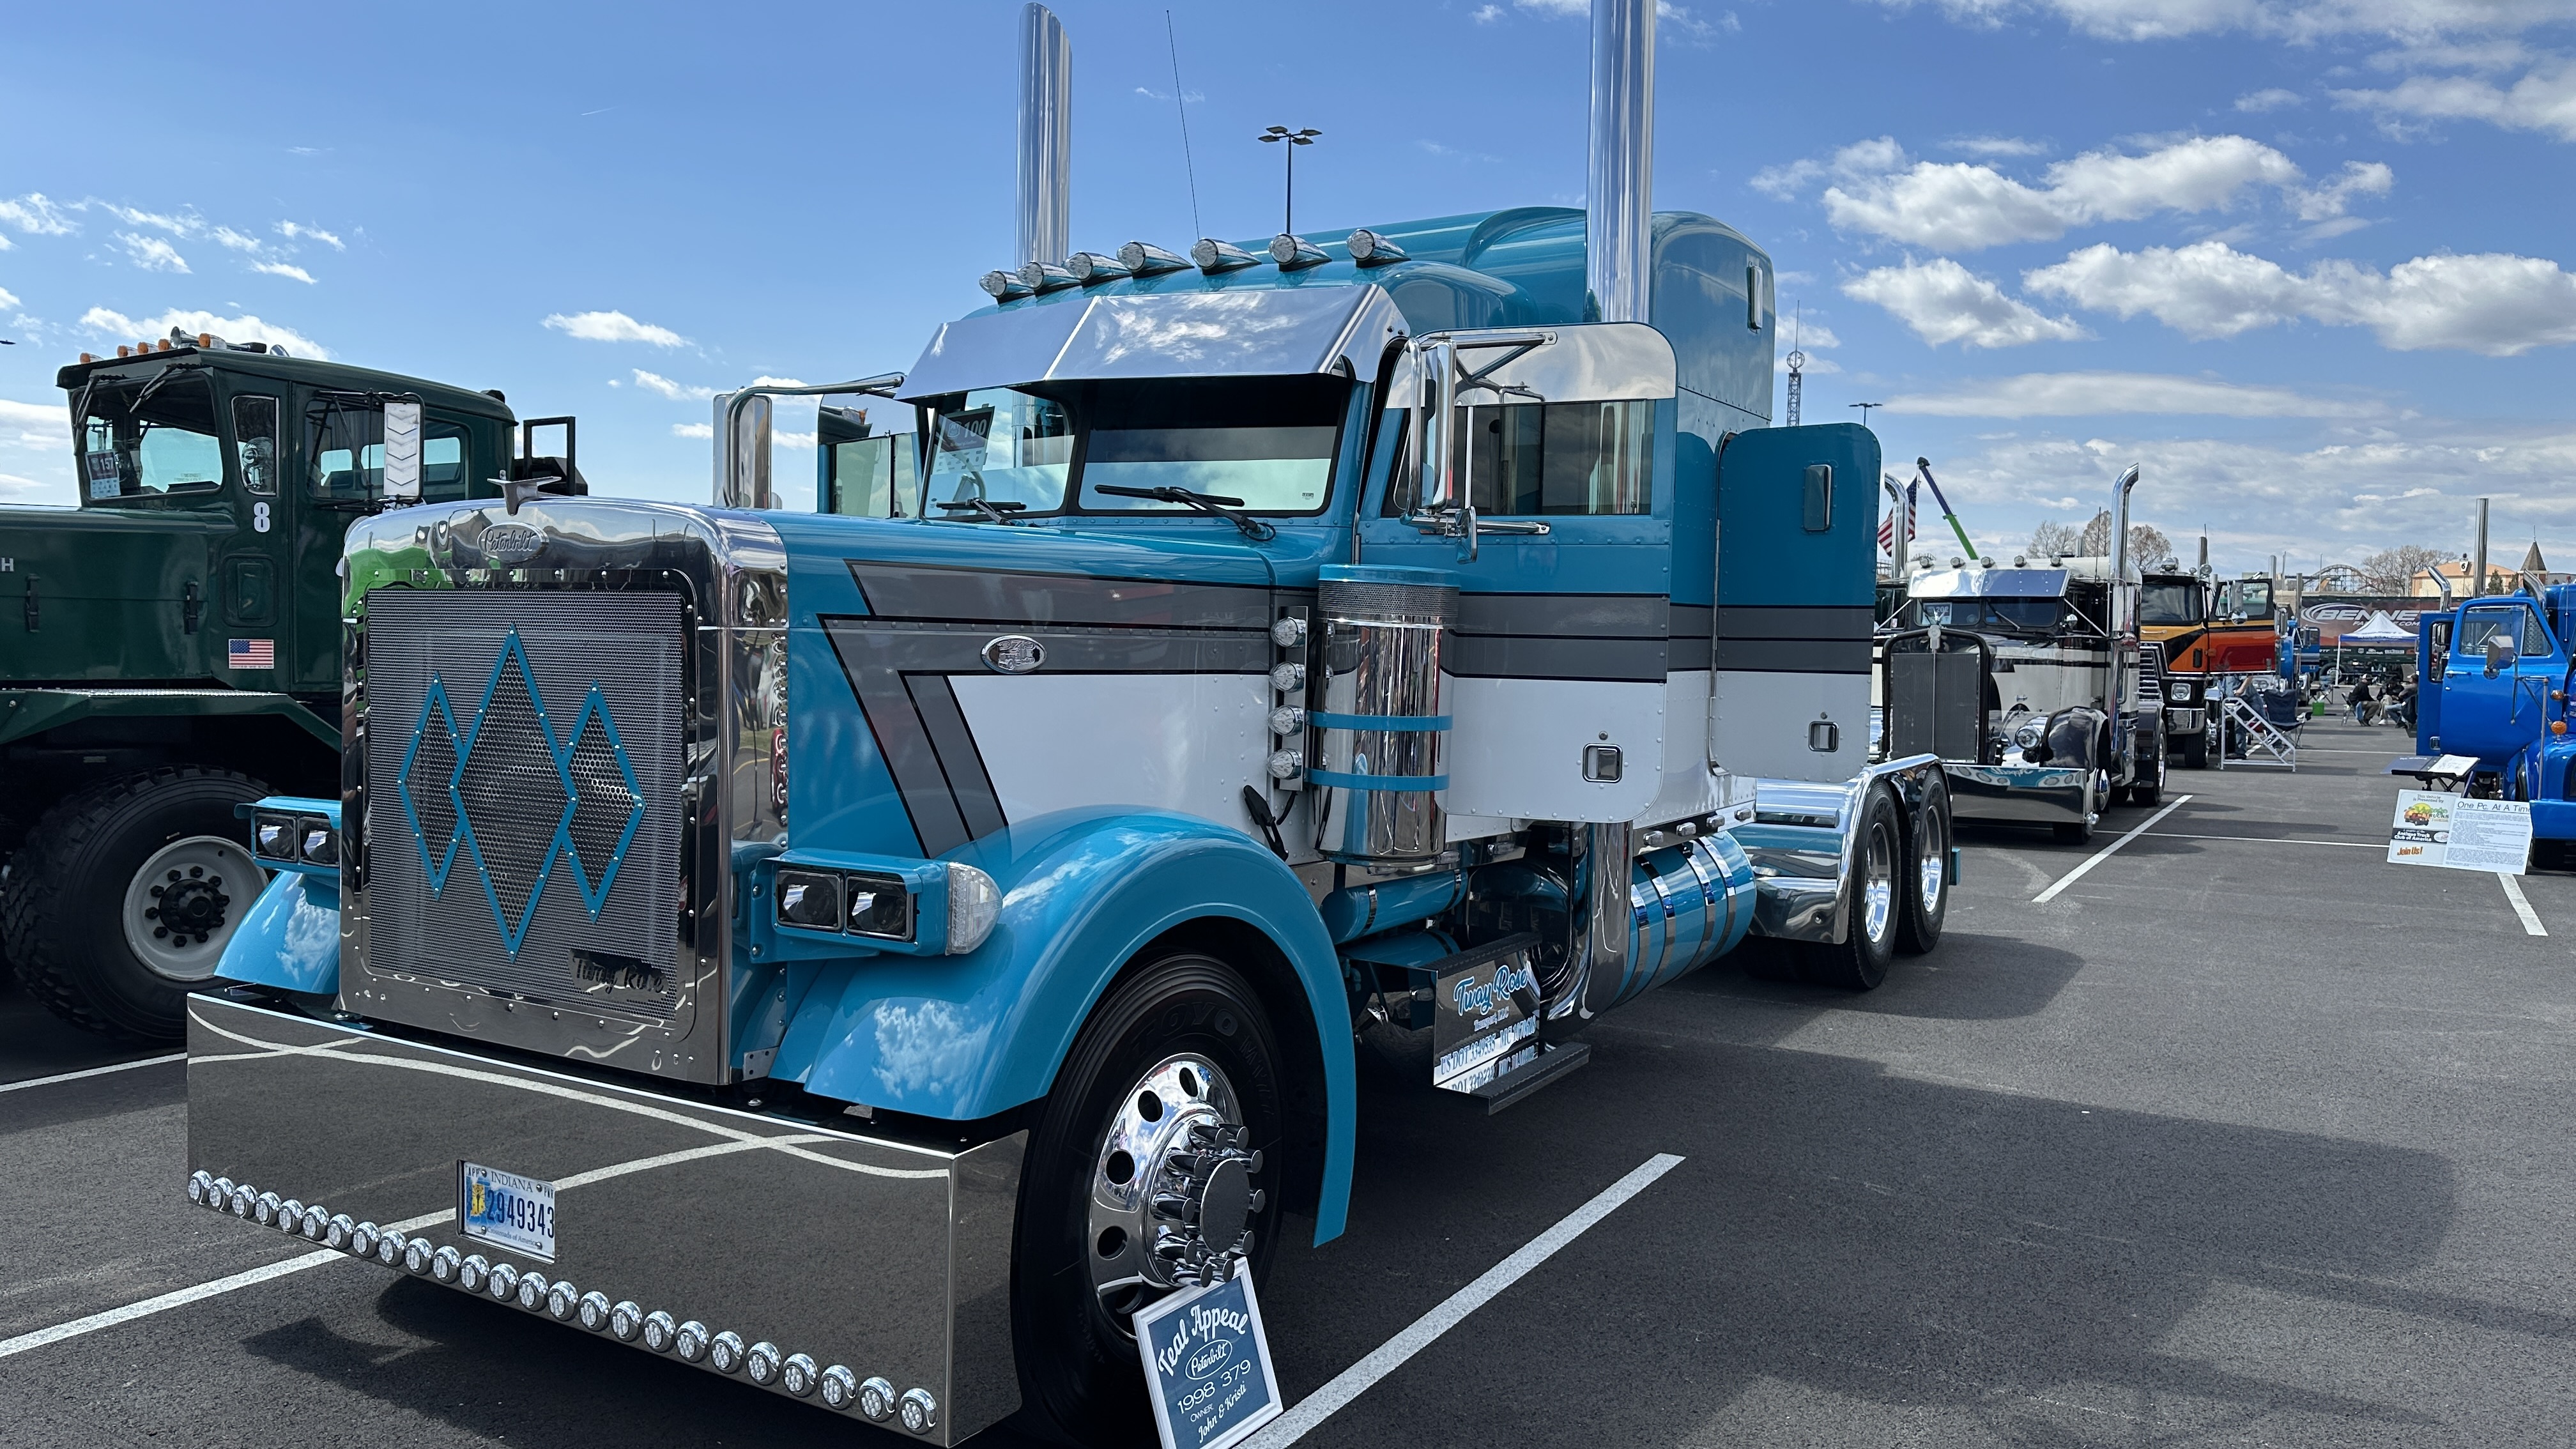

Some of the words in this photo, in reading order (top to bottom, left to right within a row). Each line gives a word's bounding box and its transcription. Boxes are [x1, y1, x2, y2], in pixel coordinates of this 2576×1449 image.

[964, 419, 987, 438] 100
[100, 457, 114, 471] 157
[254, 502, 270, 532] 8
[485, 529, 537, 553] Peterbilt
[2316, 610, 2442, 620] BENNE
[997, 640, 1035, 650] 379
[2397, 847, 2411, 855] Join
[1453, 976, 1493, 1016] Tway
[1493, 965, 1528, 1000] Rose
[1126, 1001, 1238, 1059] TOYO
[1440, 1054, 1451, 1075] US
[1452, 1045, 1469, 1070] DOT
[1500, 1025, 1512, 1047] MC
[491, 1171, 533, 1193] INDIANA
[487, 1190, 555, 1239] 2949343
[1158, 1319, 1189, 1376] Teal
[1191, 1305, 1248, 1342] Appeal
[1191, 1342, 1228, 1377] Peterbilt
[1177, 1381, 1216, 1414] 1998
[1220, 1360, 1251, 1387] 379
[1198, 1415, 1217, 1443] John
[1218, 1404, 1225, 1418] &
[1225, 1381, 1246, 1411] Kristi
